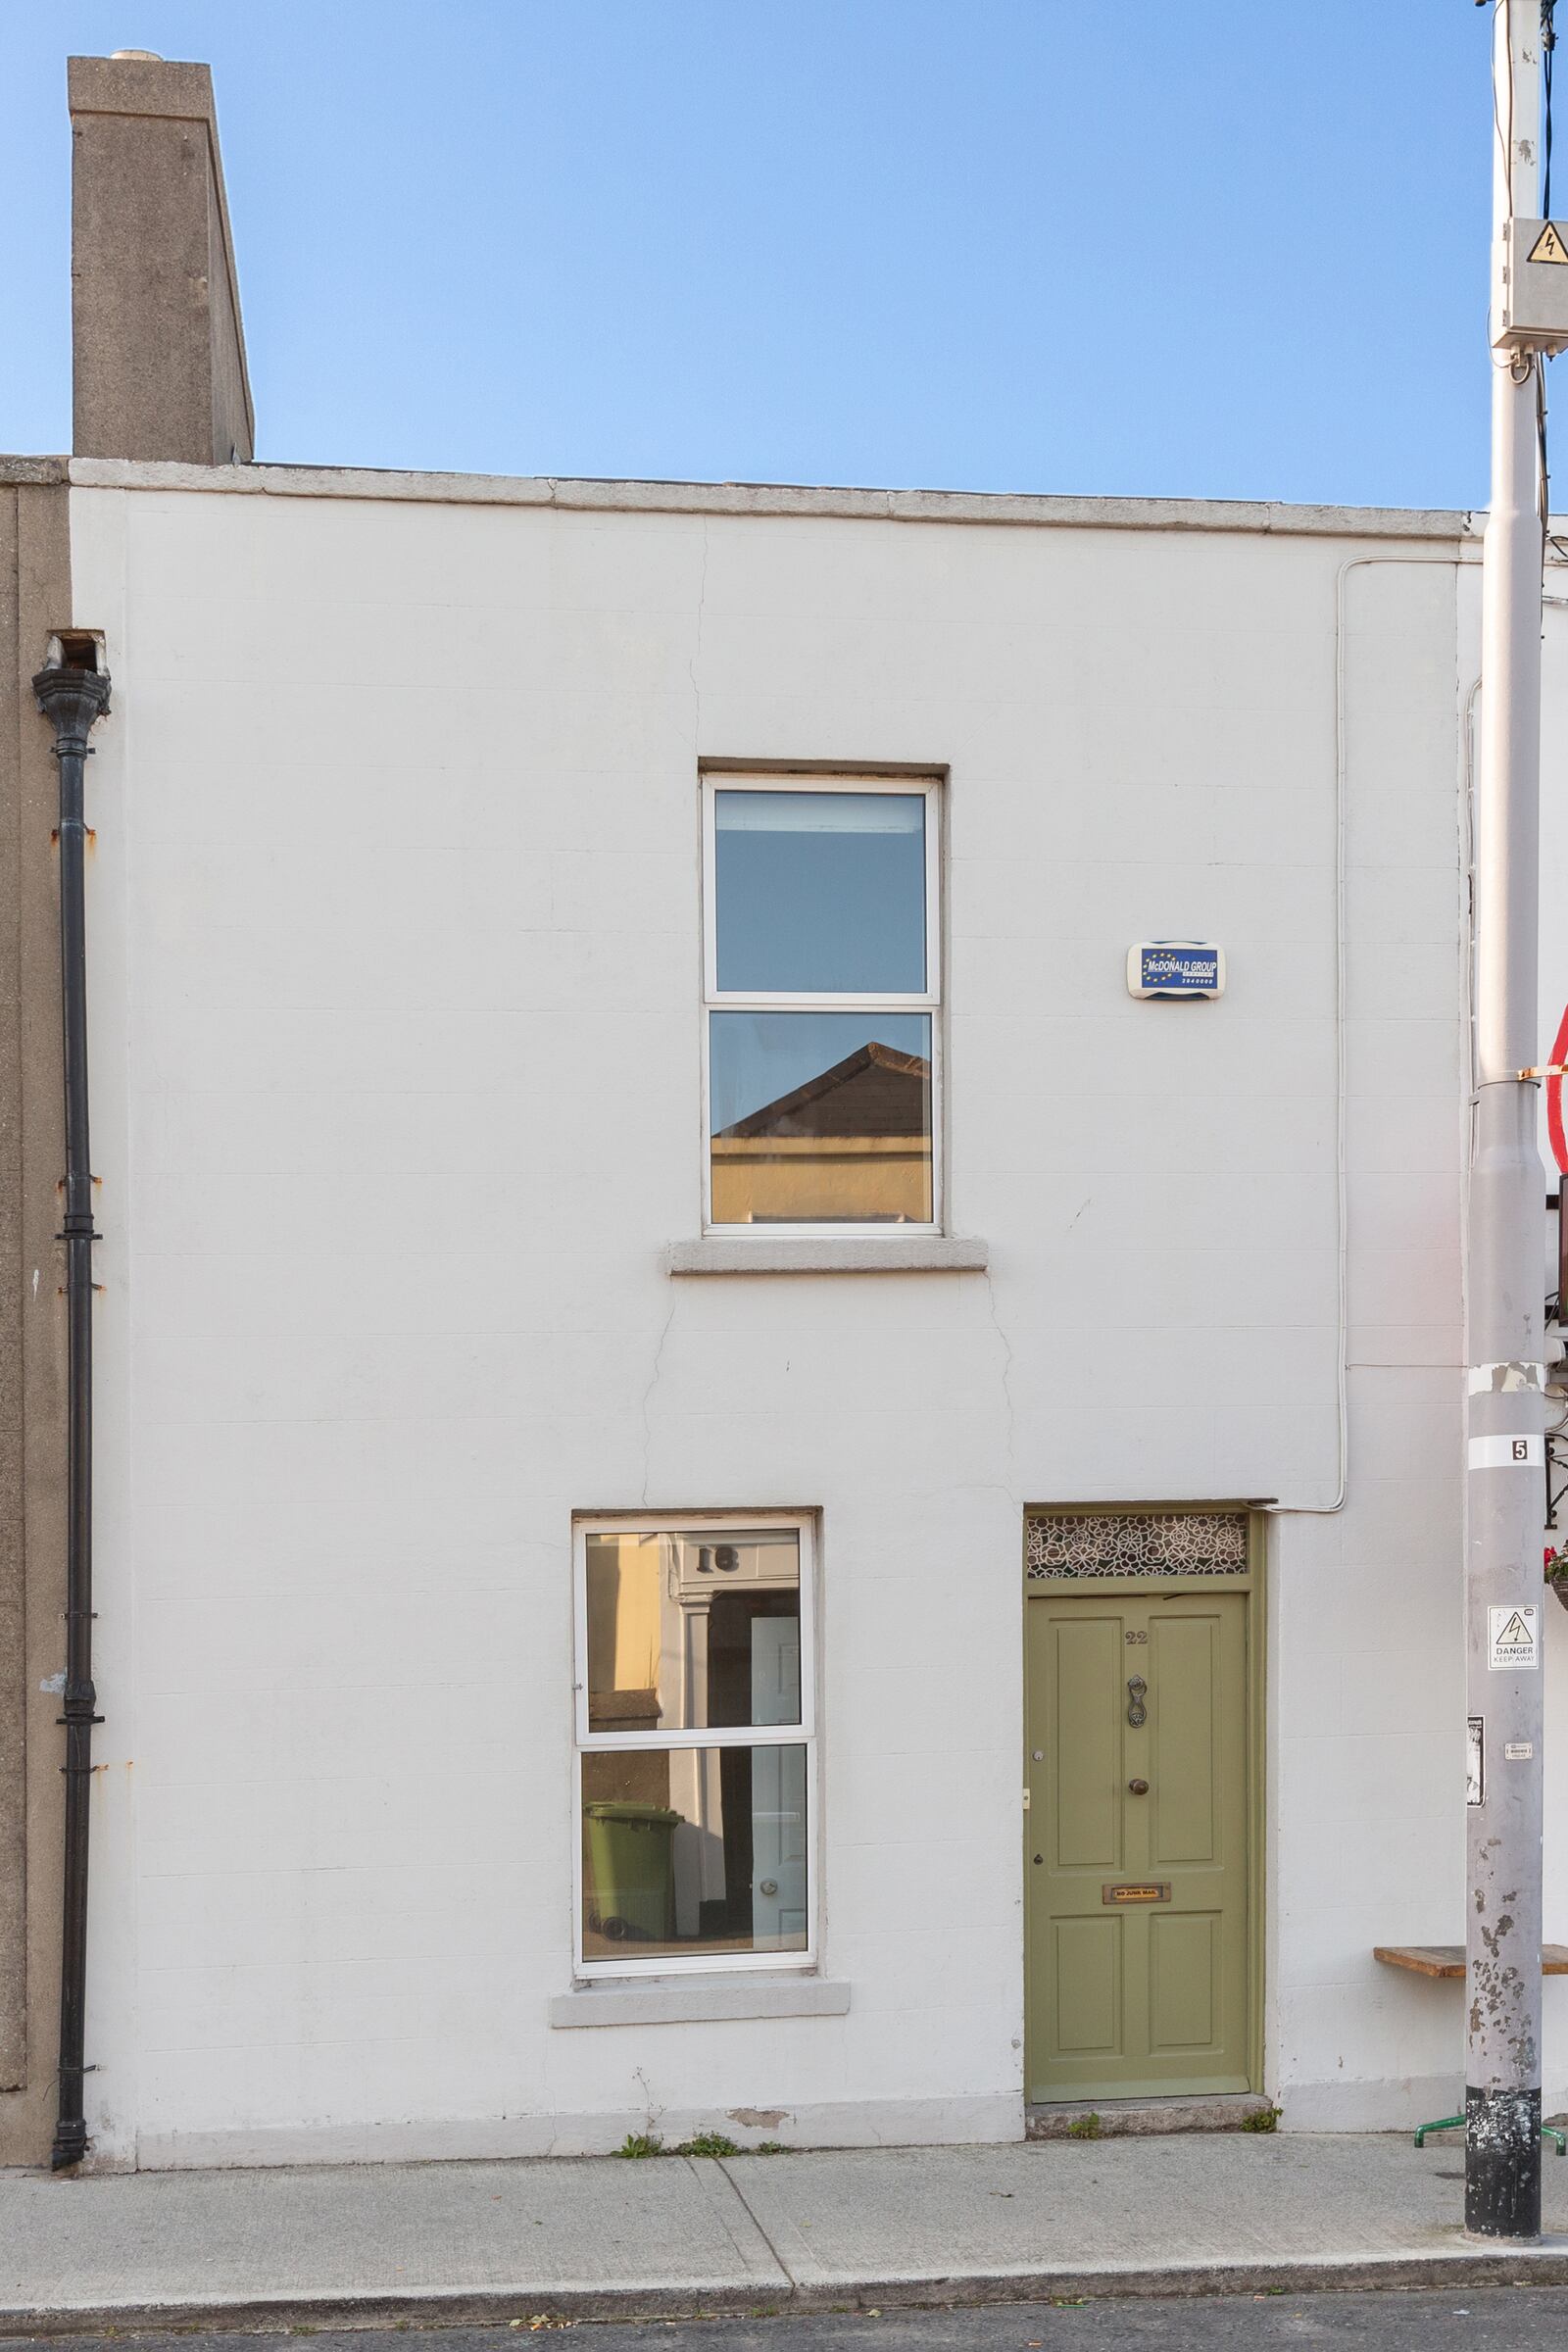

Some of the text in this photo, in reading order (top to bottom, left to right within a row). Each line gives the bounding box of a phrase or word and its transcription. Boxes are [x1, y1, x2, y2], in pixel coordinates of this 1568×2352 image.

[1148, 960, 1217, 972] McDONALD GROUP
[1515, 1442, 1526, 1459] 5
[1125, 1631, 1148, 1644] 22
